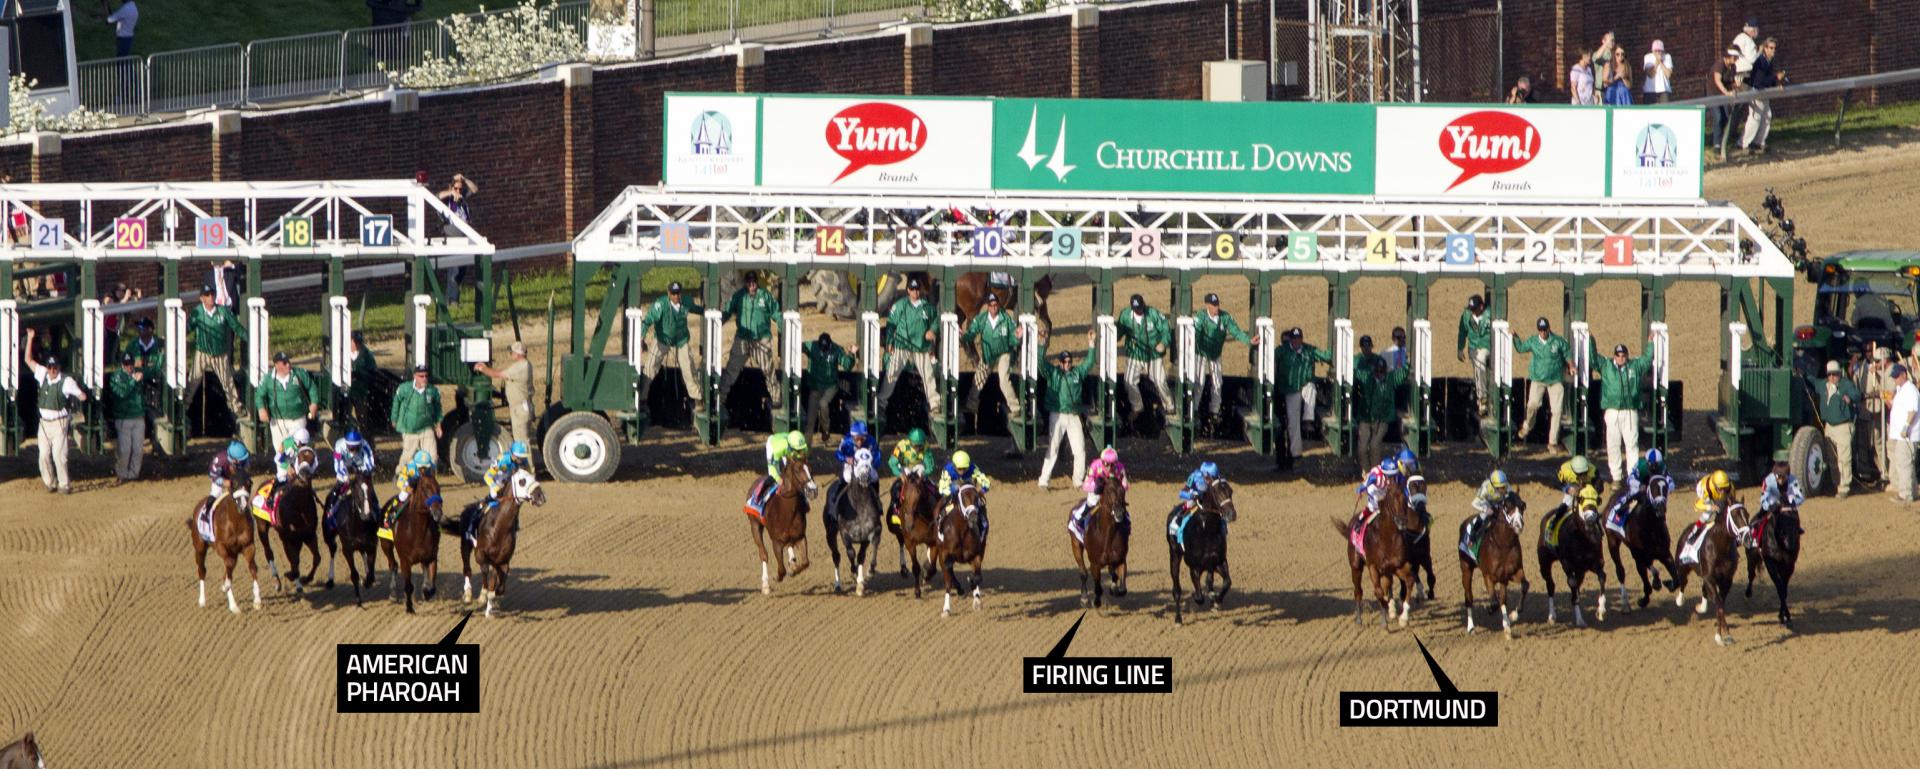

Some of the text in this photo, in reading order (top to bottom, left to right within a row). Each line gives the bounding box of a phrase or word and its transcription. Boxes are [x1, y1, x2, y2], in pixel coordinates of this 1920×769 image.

[833, 116, 920, 152] Yum!
[1447, 124, 1534, 160] Yum!
[878, 171, 919, 183] Brands
[1491, 179, 1532, 191] Brands
[38, 224, 60, 247] 21
[117, 224, 144, 248] 20
[201, 223, 224, 247] 19
[285, 220, 309, 245] 18
[364, 220, 389, 245] 17
[741, 229, 764, 250] 15
[817, 229, 843, 253] 14
[897, 230, 921, 254] 13
[975, 230, 1000, 255] 10
[1058, 233, 1075, 256] 9
[1138, 234, 1154, 256] 8
[1216, 233, 1235, 258] 6
[1293, 236, 1310, 257] 5
[1371, 238, 1390, 258] 4
[1451, 238, 1470, 259] 3
[1531, 240, 1547, 262] 2
[1612, 242, 1626, 264] 1
